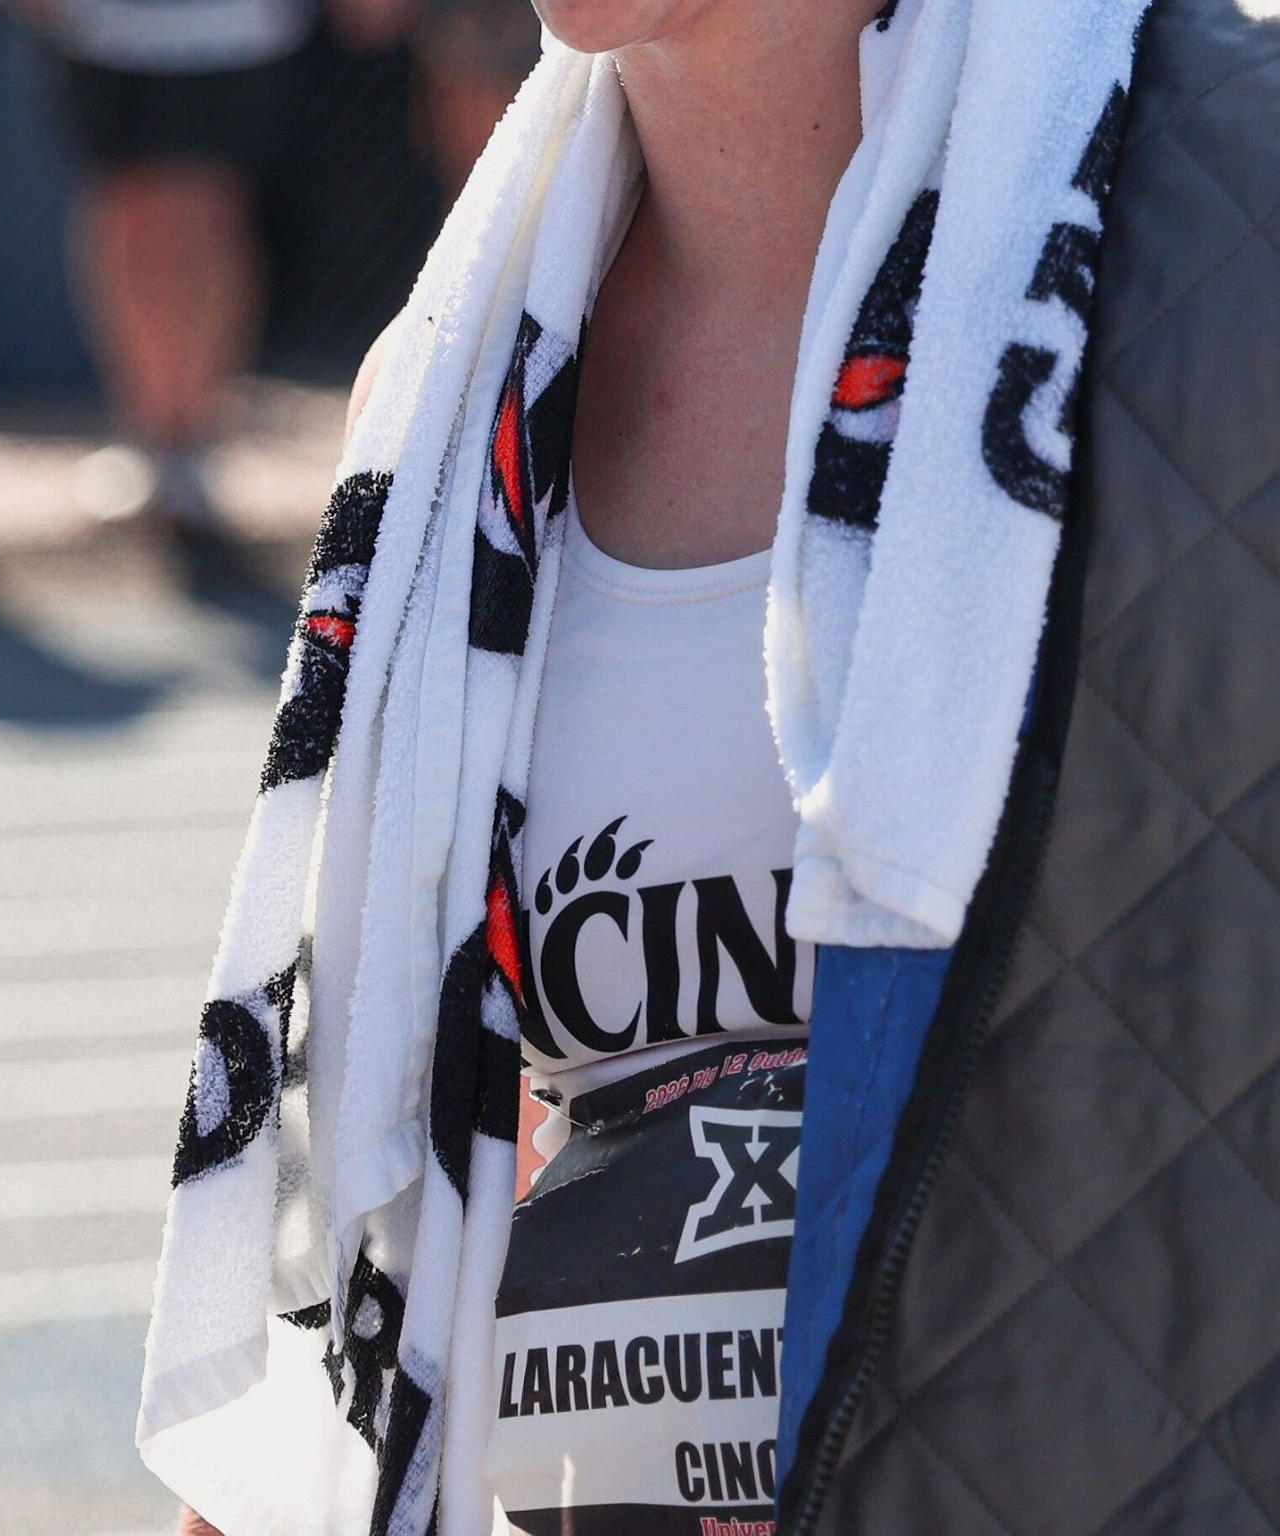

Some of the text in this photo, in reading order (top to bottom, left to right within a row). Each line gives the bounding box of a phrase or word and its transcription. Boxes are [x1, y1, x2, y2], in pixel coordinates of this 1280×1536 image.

[643, 1076, 690, 1114] 2026
[720, 1053, 748, 1078] 12
[498, 1328, 784, 1419] LARACUEN
